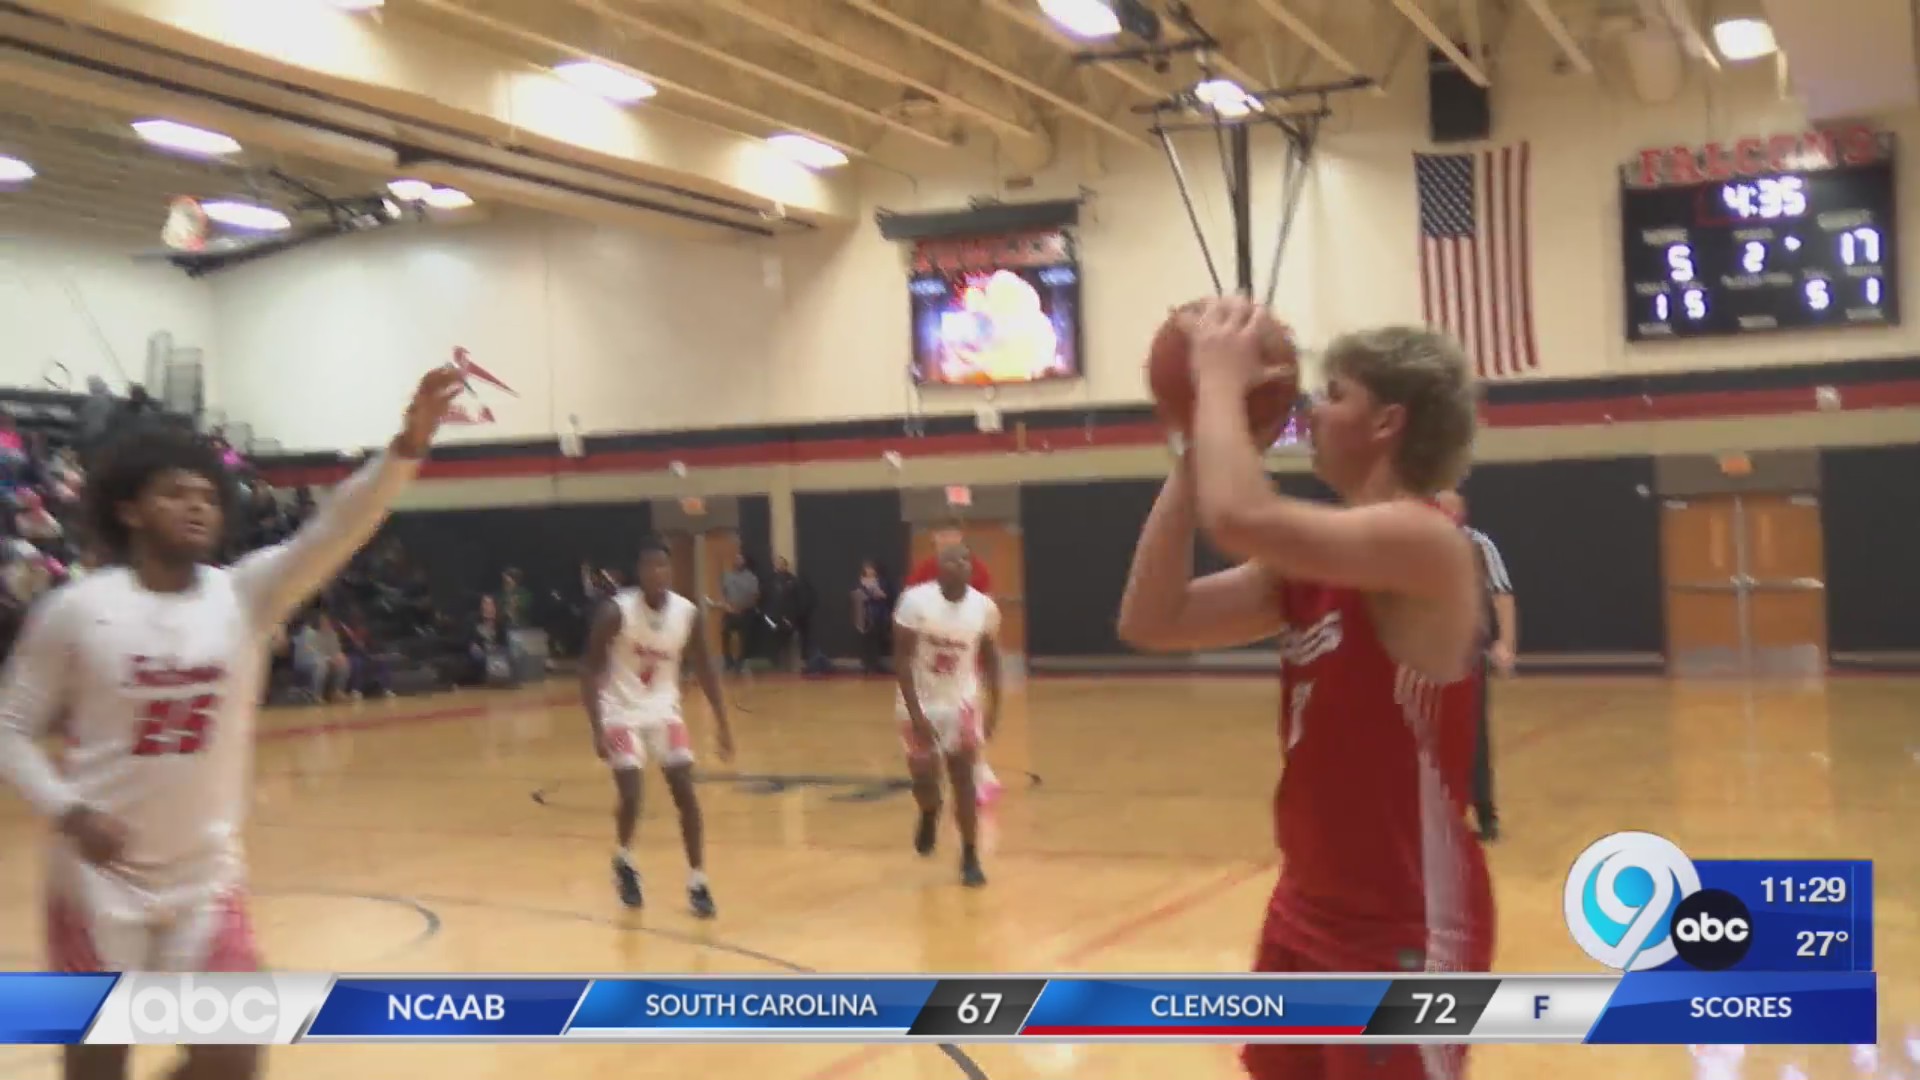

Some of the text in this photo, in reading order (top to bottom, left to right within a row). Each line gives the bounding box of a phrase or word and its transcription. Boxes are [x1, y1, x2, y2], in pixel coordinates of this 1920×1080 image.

[1722, 175, 1807, 218] 4:35
[1667, 244, 1694, 281] 5
[1742, 241, 1766, 273] 2
[1840, 227, 1880, 266] 17
